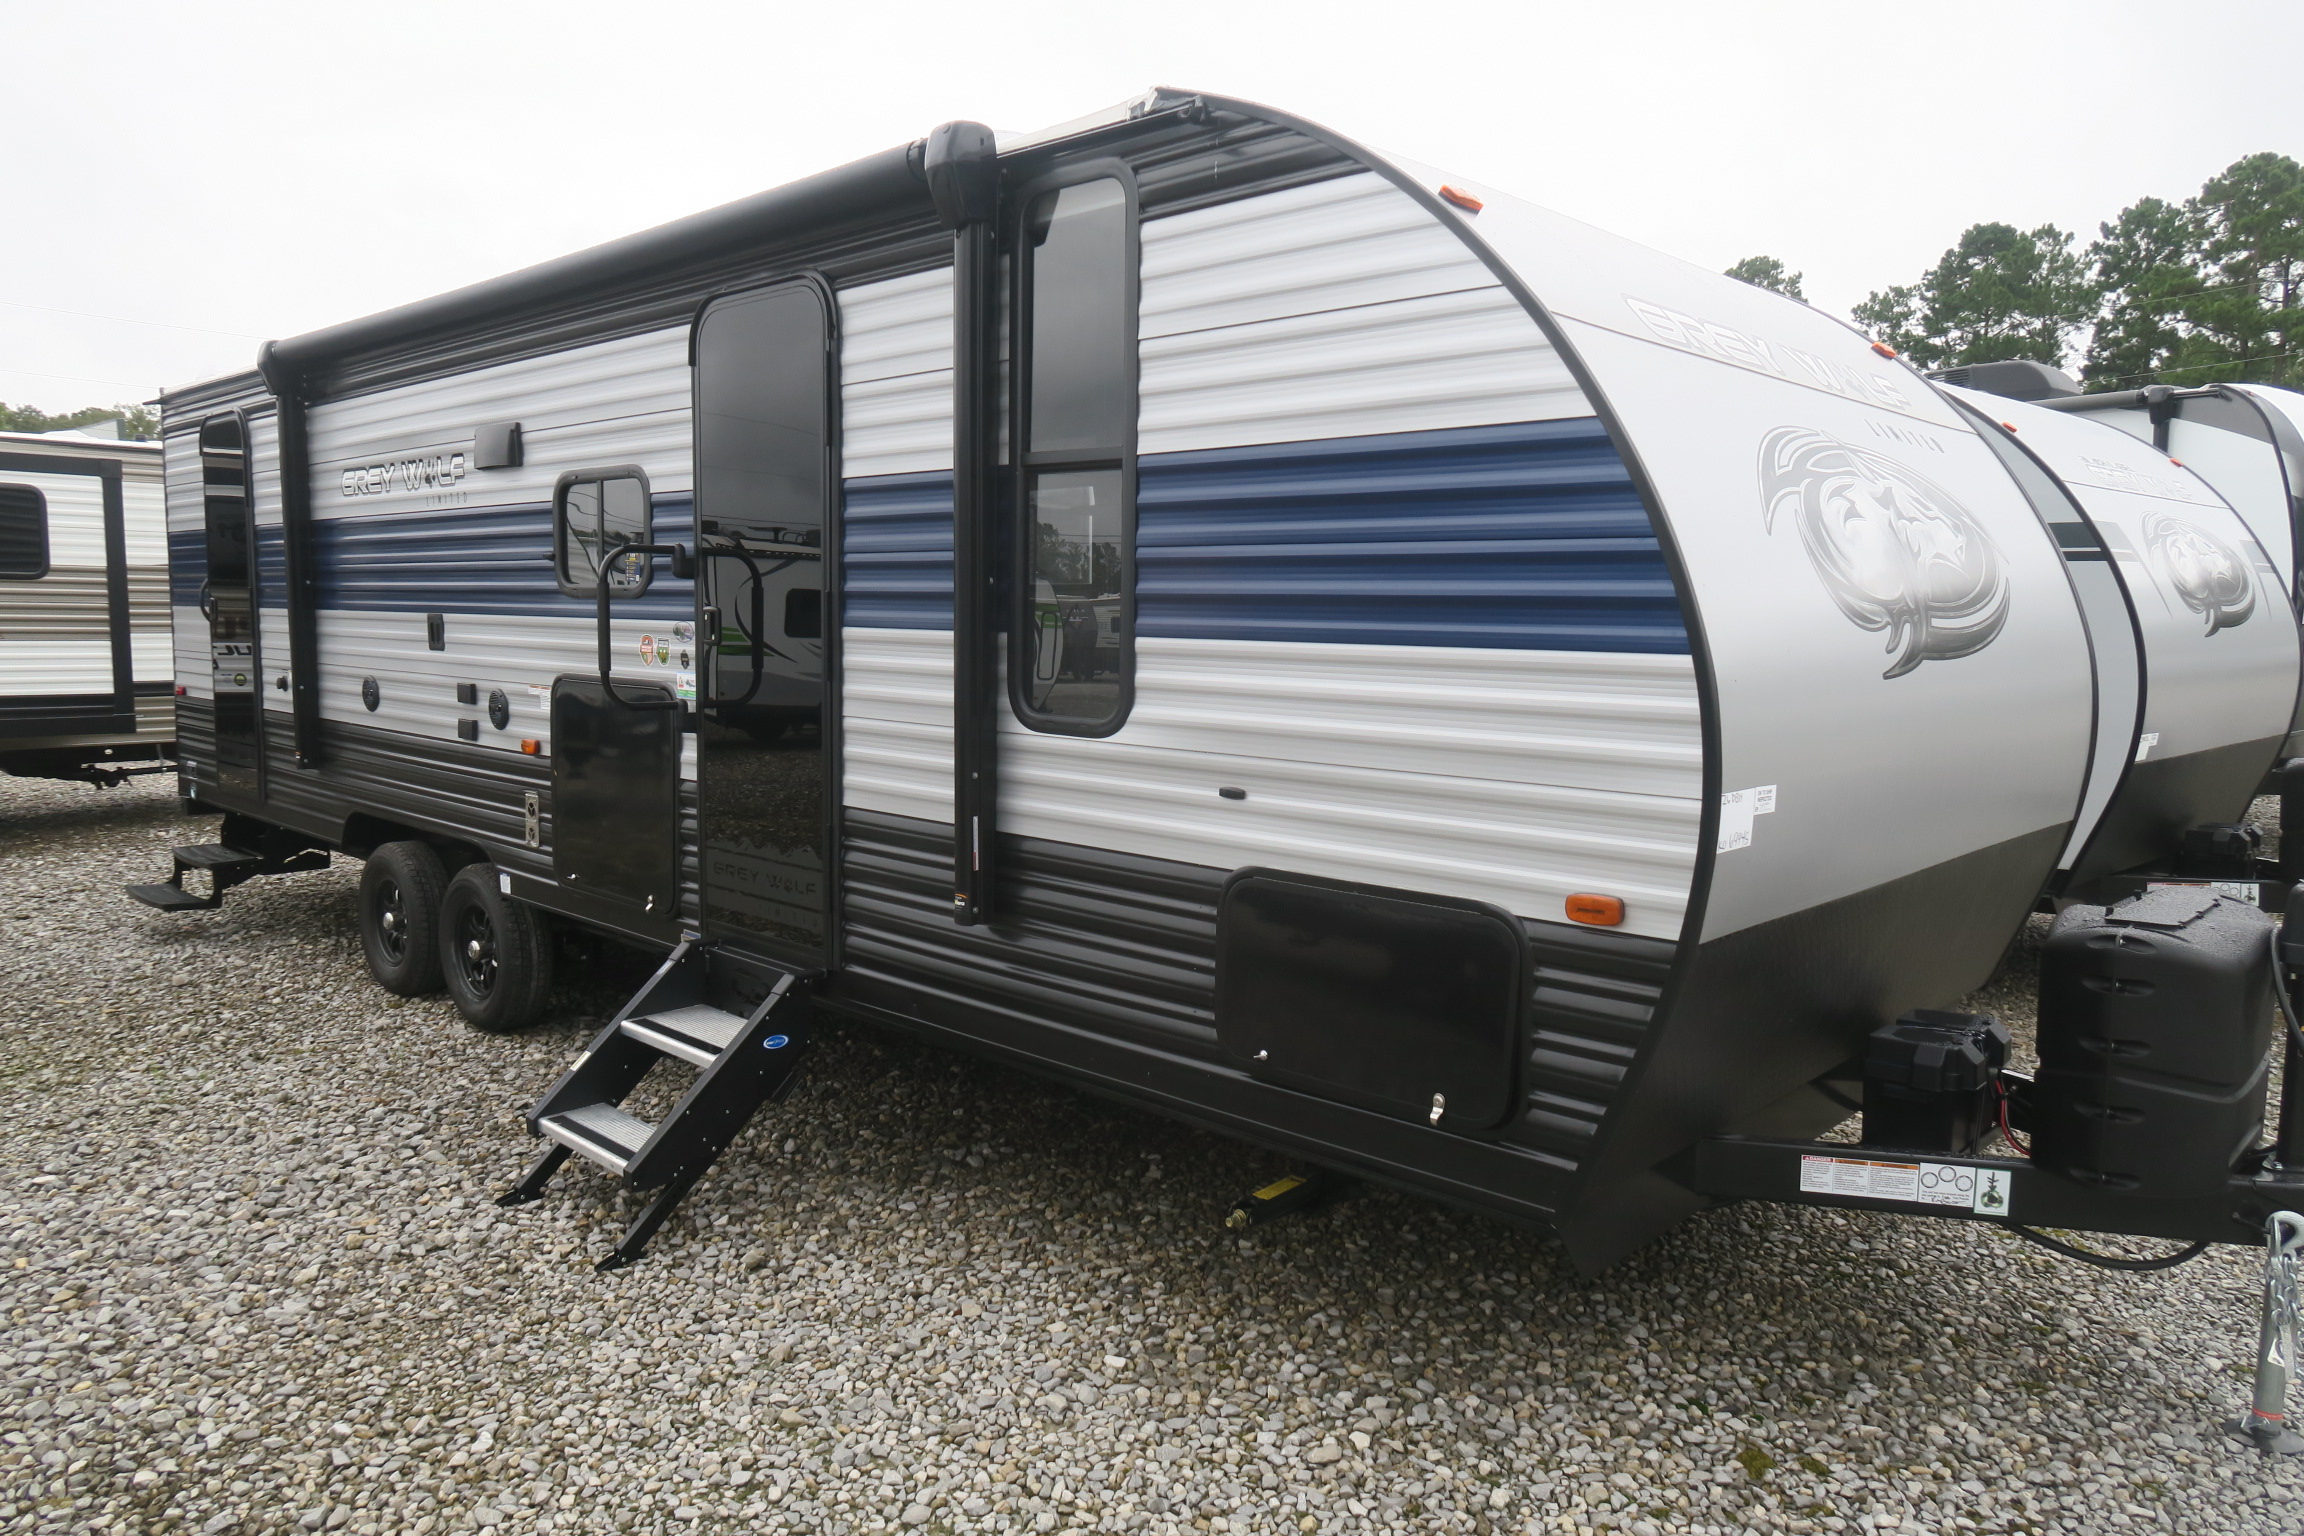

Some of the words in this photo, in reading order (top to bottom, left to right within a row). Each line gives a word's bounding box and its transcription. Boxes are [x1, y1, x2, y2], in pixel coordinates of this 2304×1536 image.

[1621, 292, 1786, 378] GREY
[342, 463, 395, 495] GREY
[426, 492, 467, 506] LIMITED
[713, 861, 759, 883] GREY
